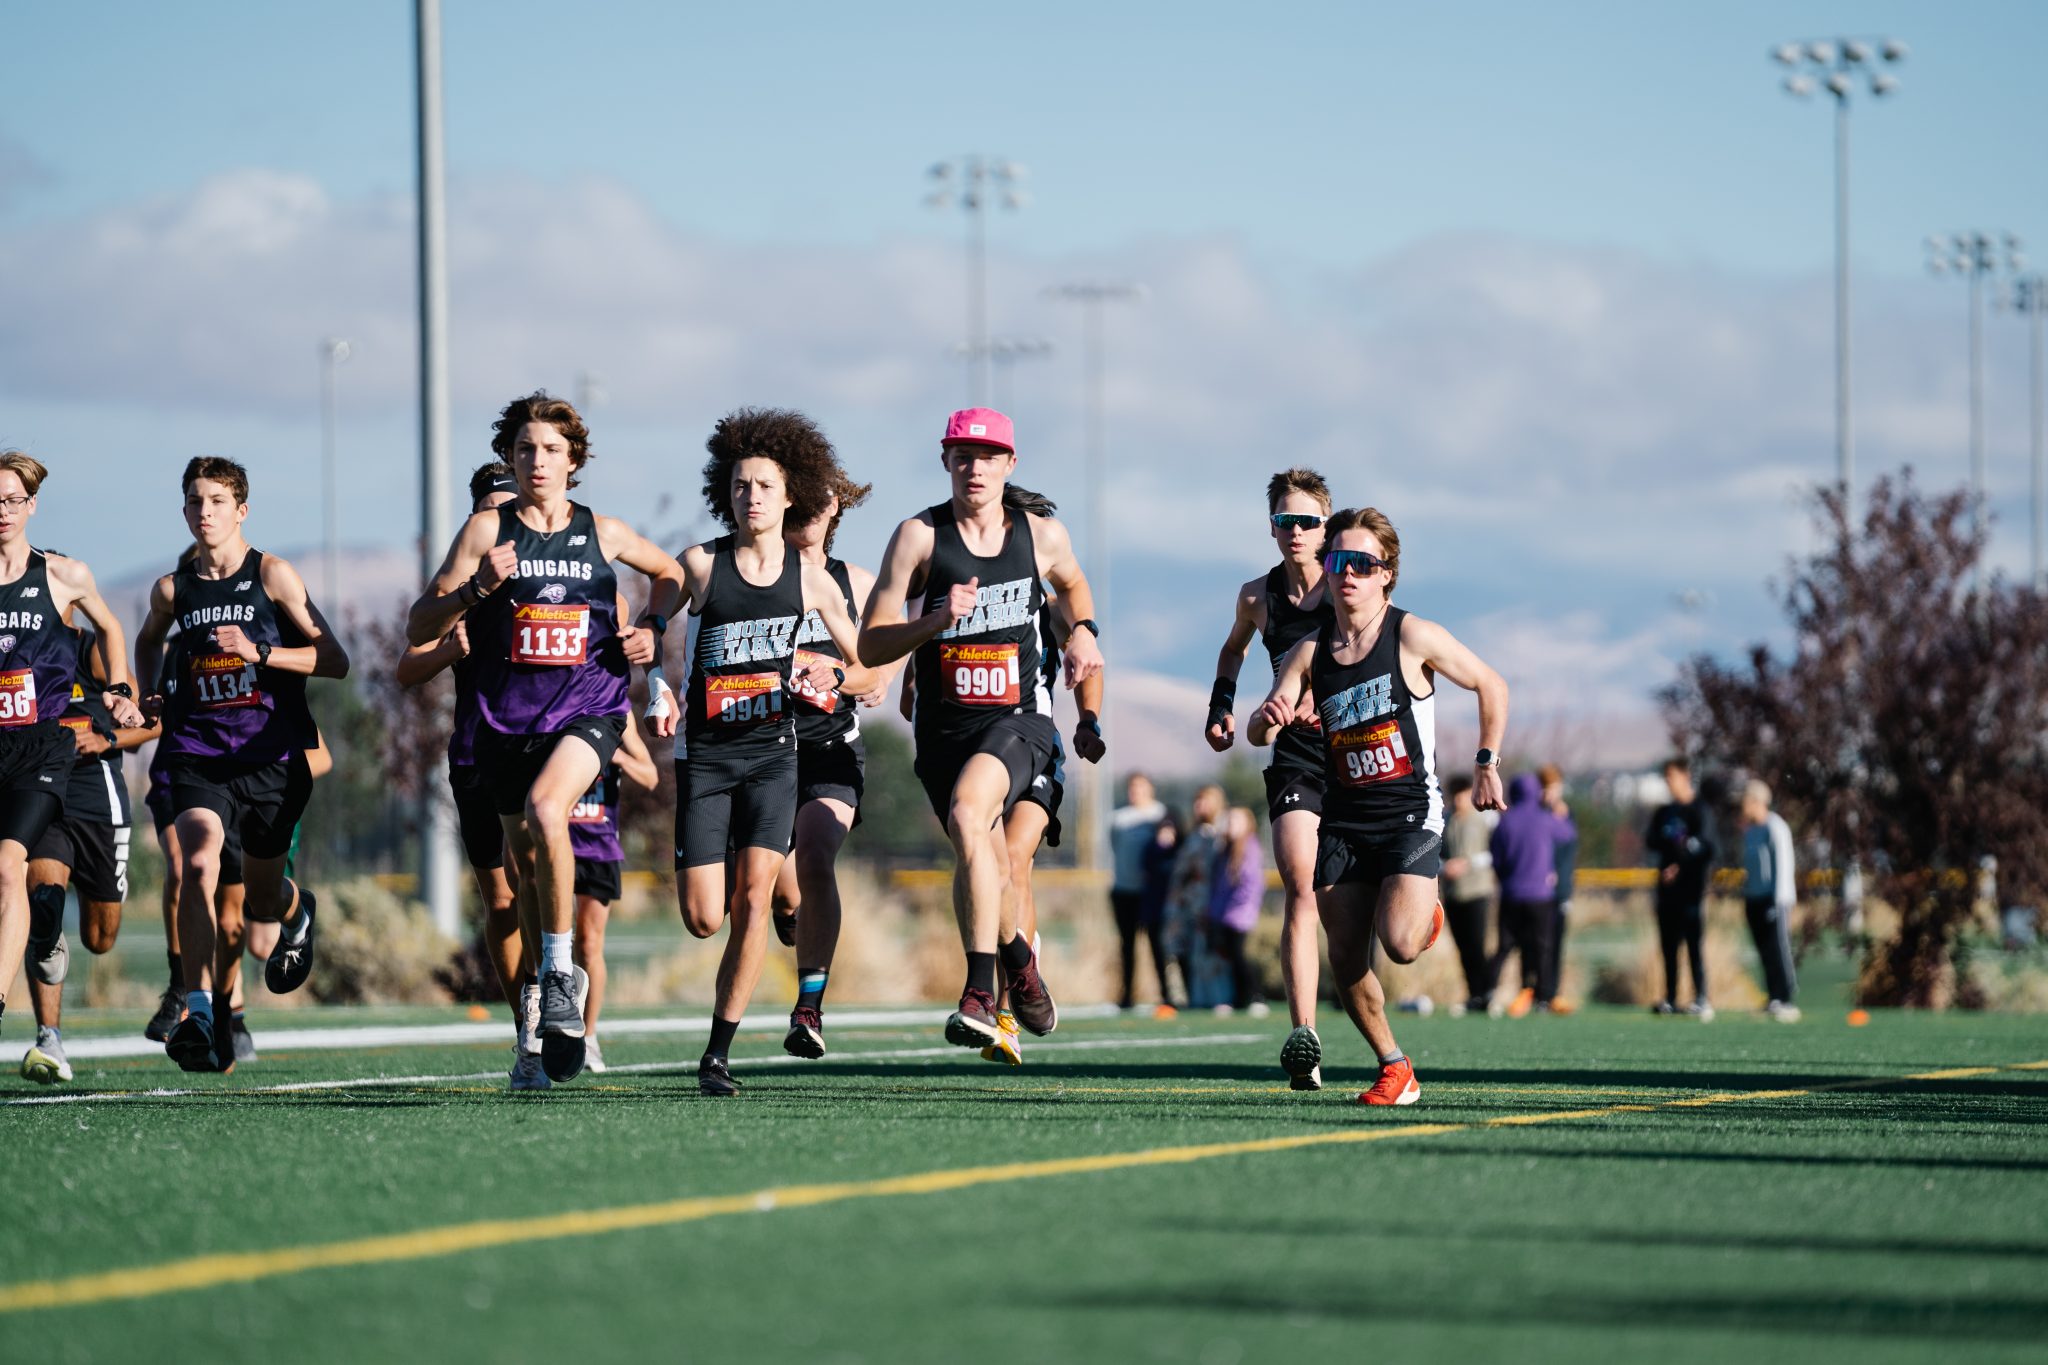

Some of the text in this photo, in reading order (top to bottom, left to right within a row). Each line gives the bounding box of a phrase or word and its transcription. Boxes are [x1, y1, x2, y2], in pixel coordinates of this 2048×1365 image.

[975, 577, 1032, 607] ORTH
[0, 611, 43, 631] GARS
[183, 604, 255, 630] COUGARS
[724, 615, 798, 641] NORTH
[519, 626, 582, 657] 1133
[197, 673, 253, 702] 1134
[955, 667, 1006, 696] 990
[1332, 673, 1393, 709] NORTH
[0, 690, 30, 718] 36
[721, 695, 769, 723] 994
[1337, 690, 1392, 722] TAHOE
[1346, 746, 1395, 779] 989
